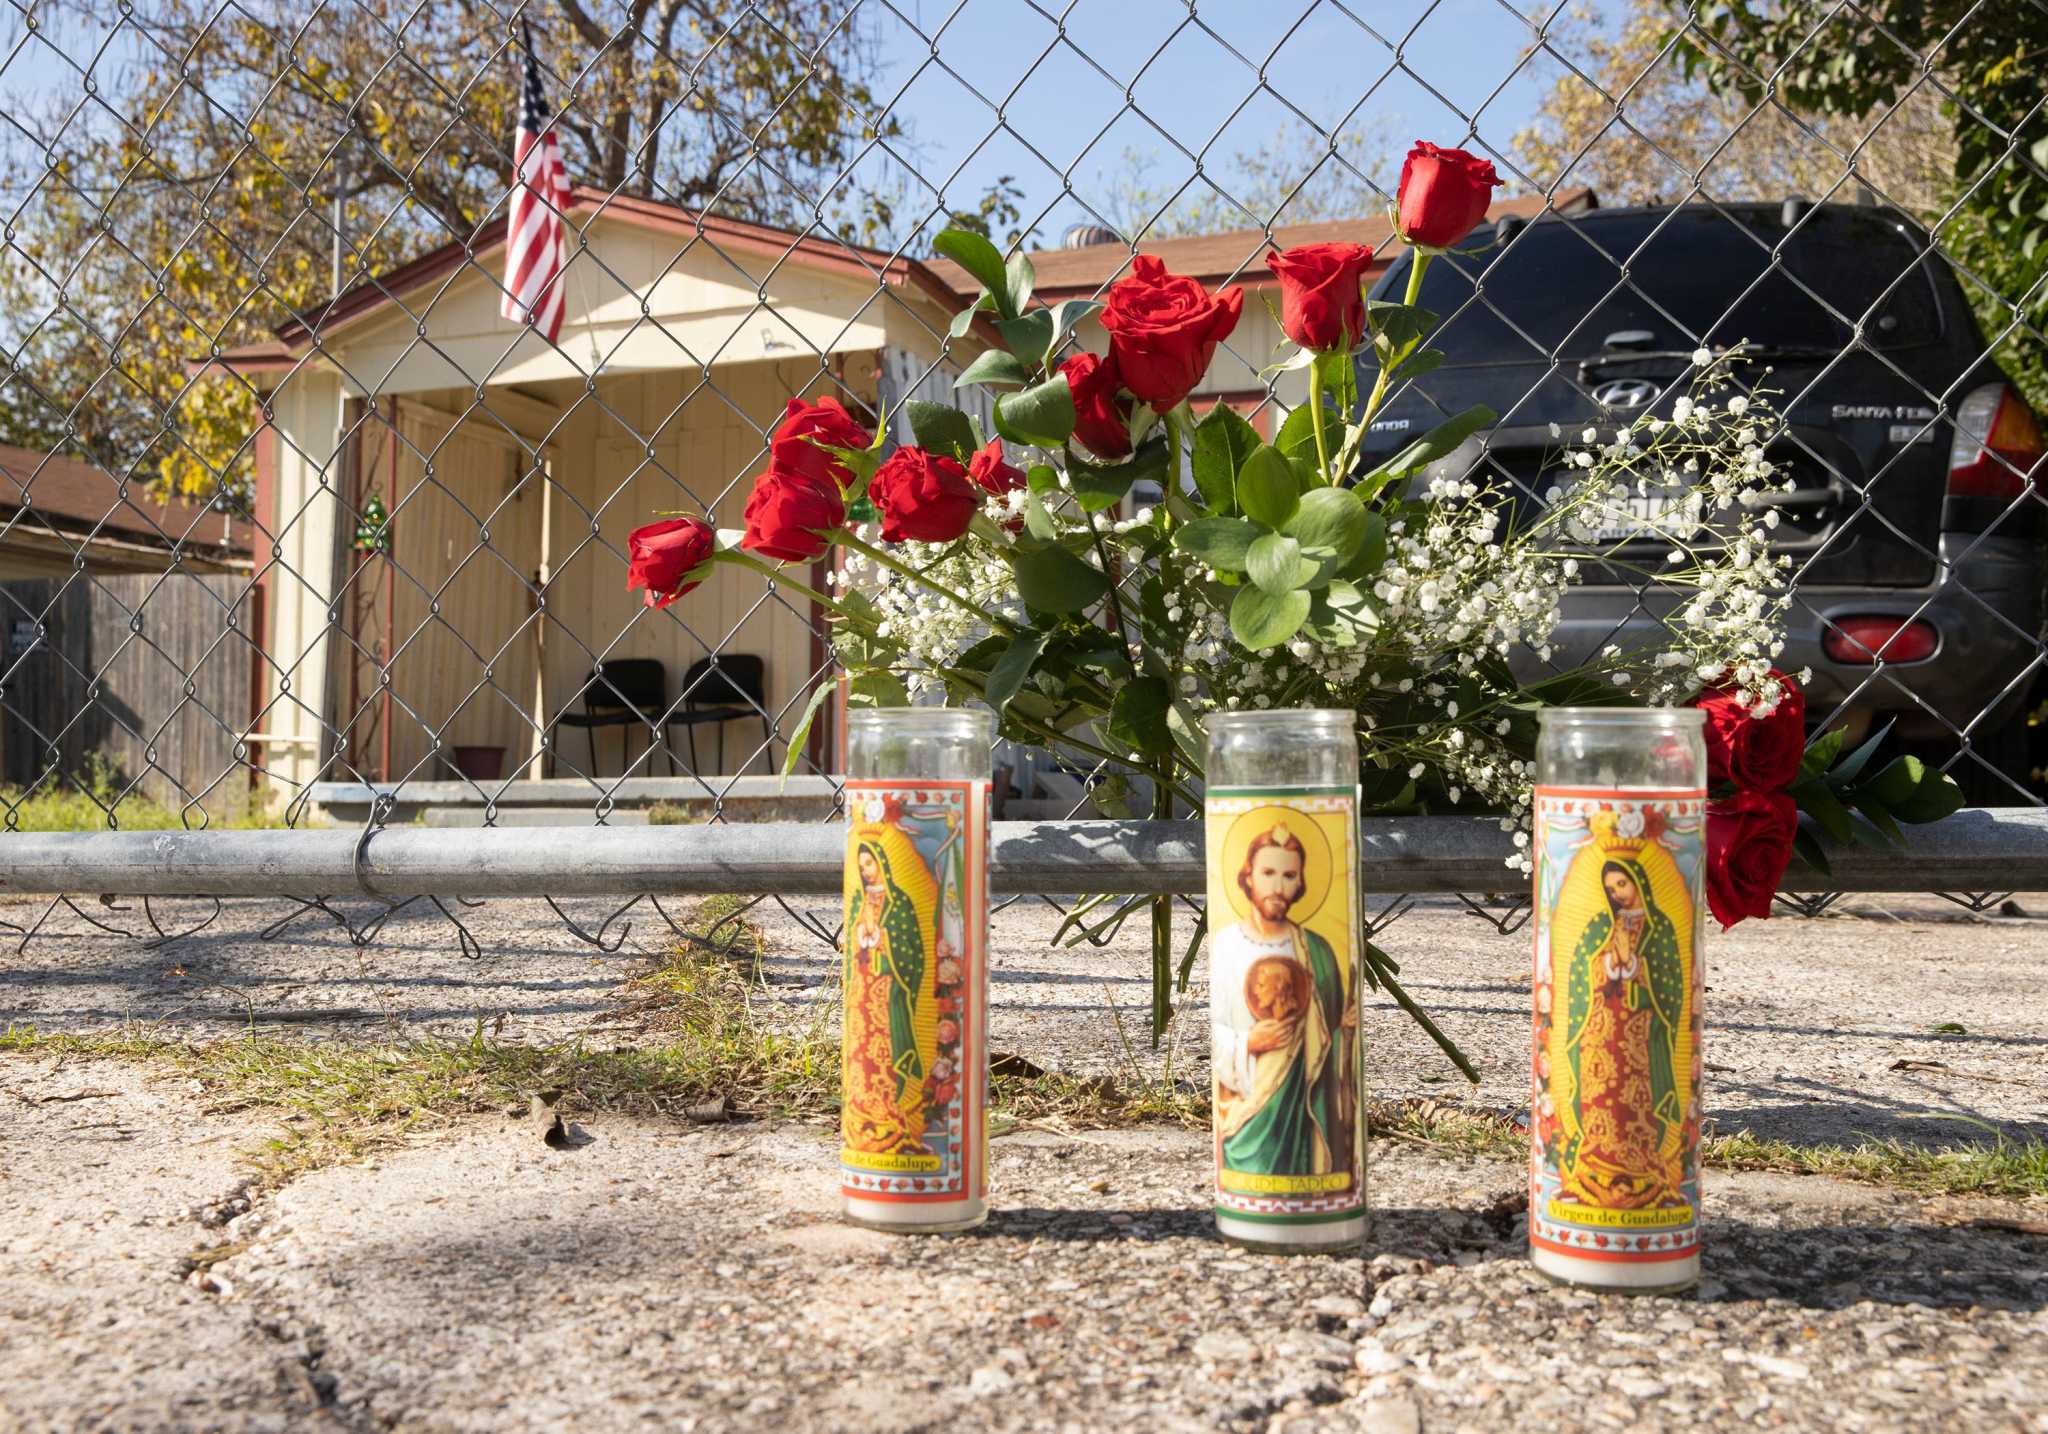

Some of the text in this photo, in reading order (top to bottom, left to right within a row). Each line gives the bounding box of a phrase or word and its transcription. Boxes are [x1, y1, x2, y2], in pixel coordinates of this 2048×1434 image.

[1831, 404, 1893, 419] SANTA
[867, 1155, 937, 1172] Guadalupe
[1550, 1202, 1690, 1226] Virgen de Guadalupe
